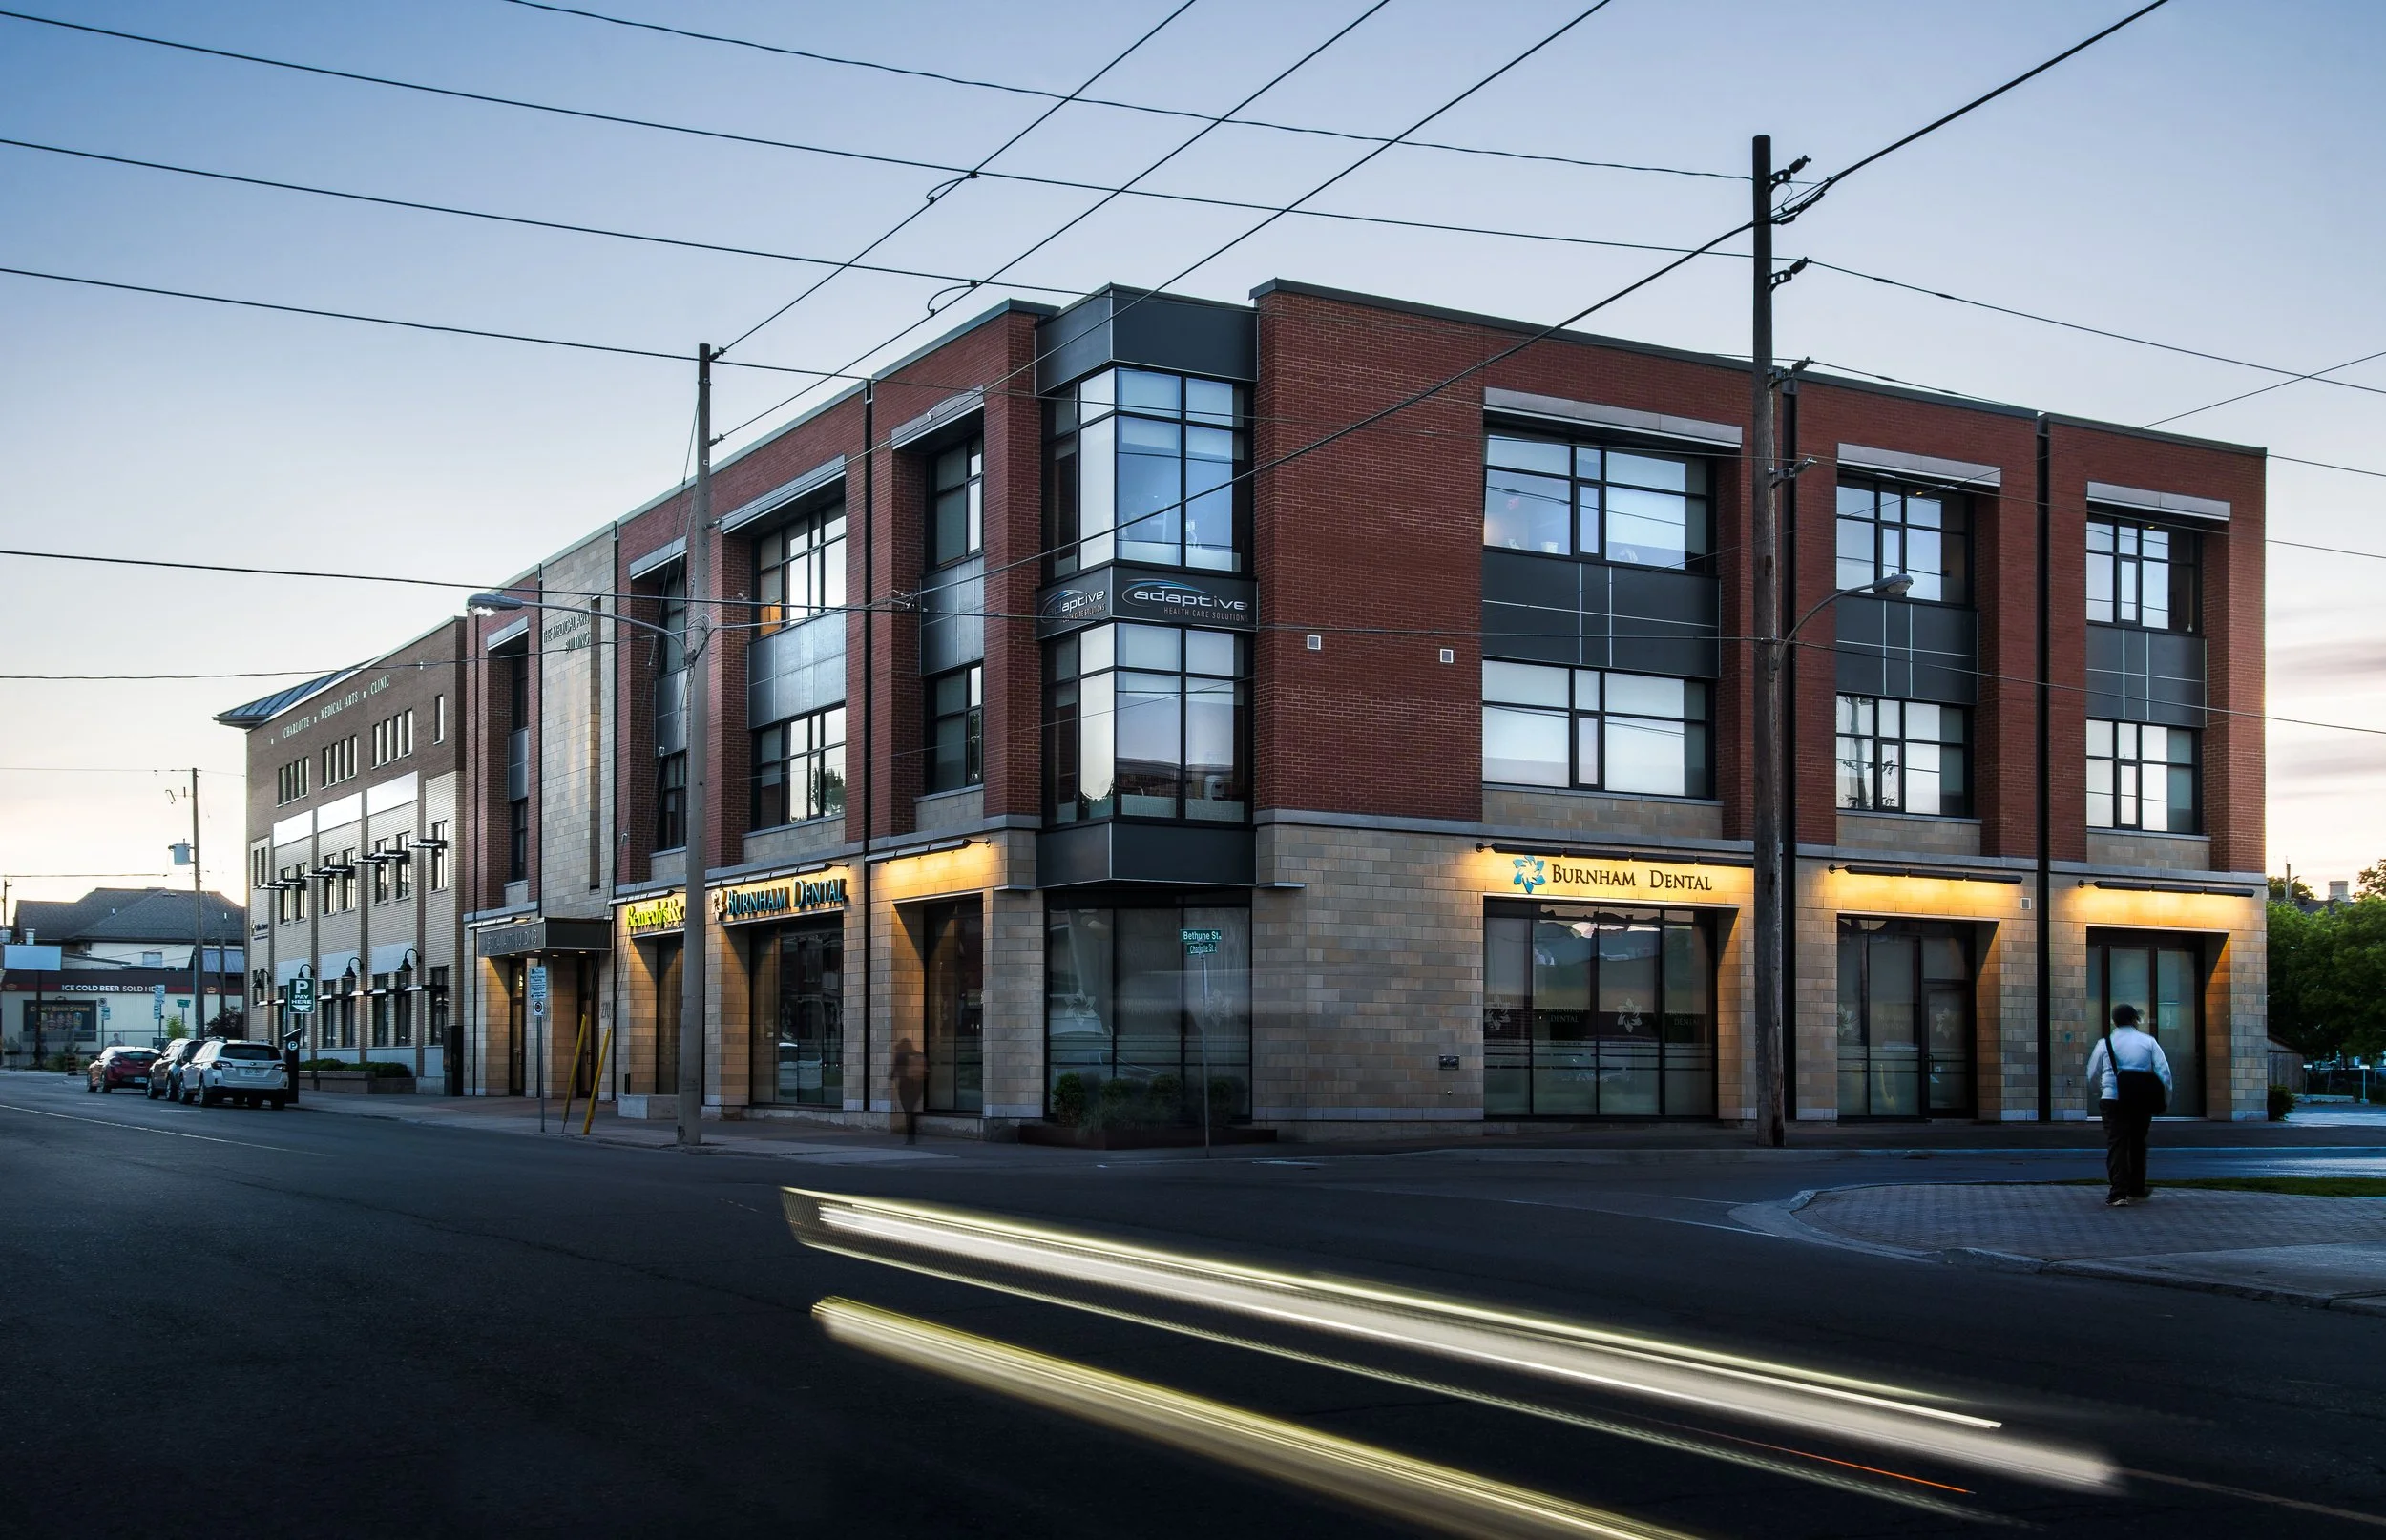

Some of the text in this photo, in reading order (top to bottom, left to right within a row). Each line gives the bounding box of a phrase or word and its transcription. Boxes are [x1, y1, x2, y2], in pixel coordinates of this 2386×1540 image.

[1047, 590, 1105, 615] adaptive
[1133, 590, 1248, 610] adaptive
[1163, 607, 1248, 622] HEALTH CARE SOLUTIONS
[283, 674, 390, 739] CHARLOTTE MEDICAL ARTS CLINIC
[1551, 864, 1713, 891] BURNHAM DENTAL
[727, 878, 845, 915] BURNHAM DENTAL
[1183, 931, 1210, 940] Bethune
[295, 980, 309, 994] P
